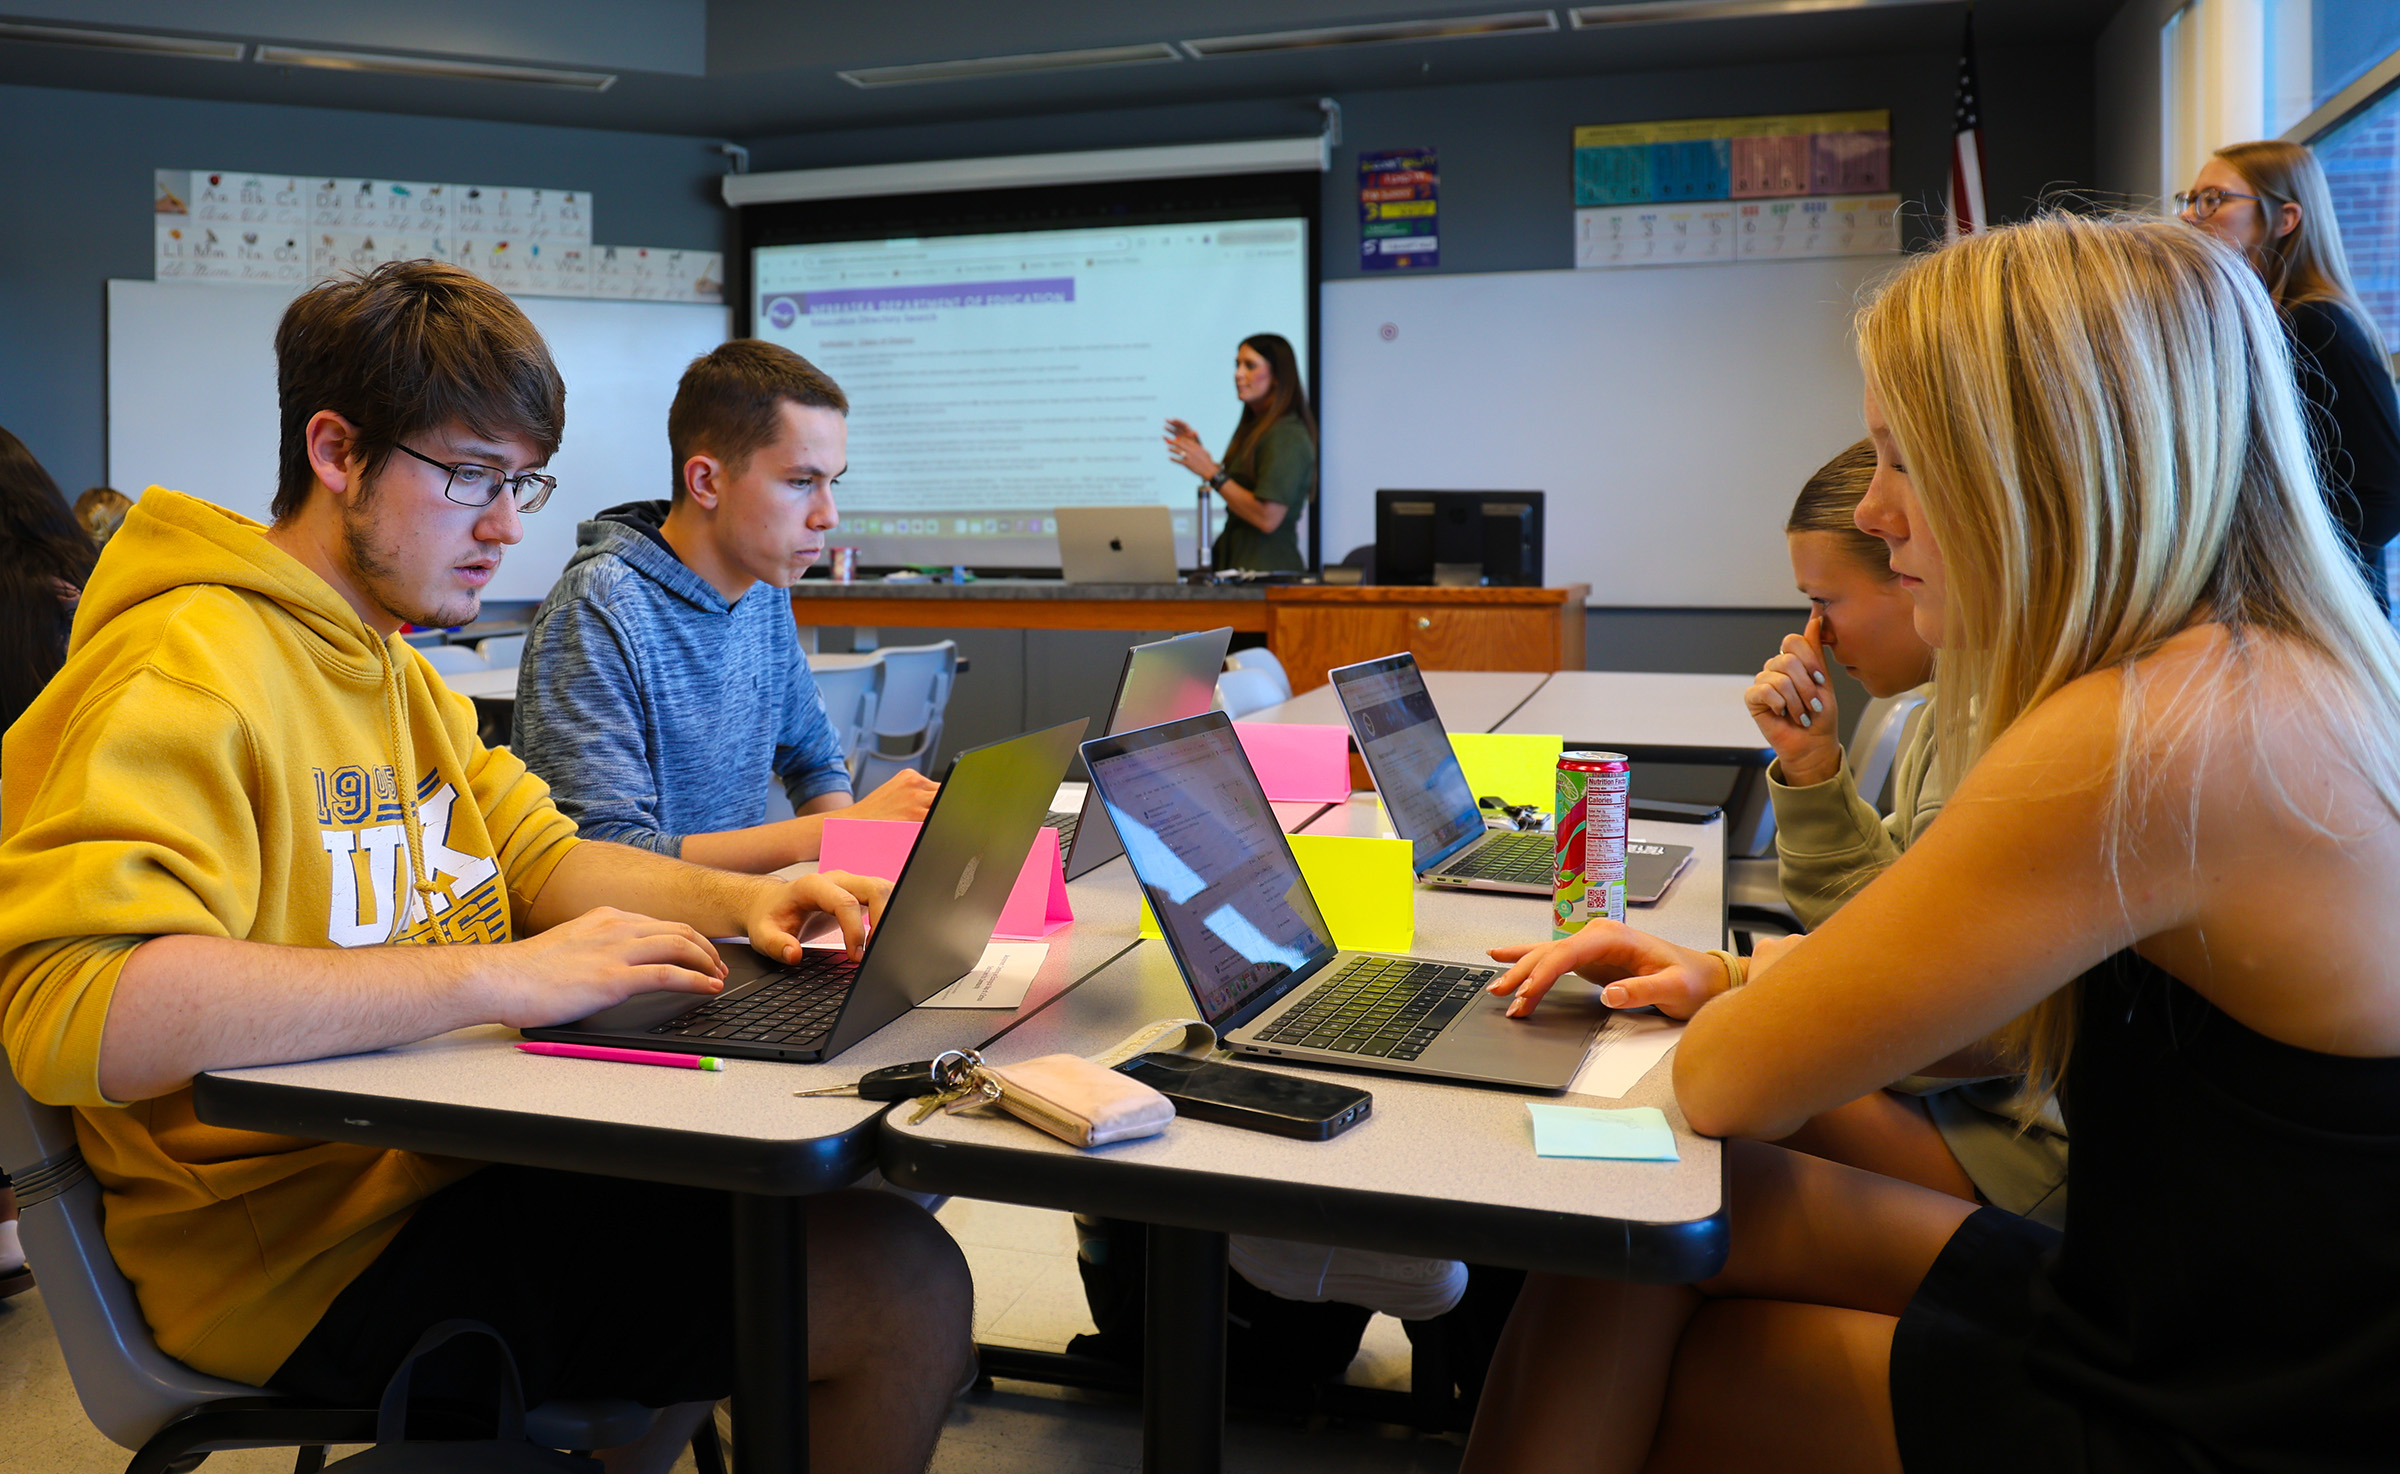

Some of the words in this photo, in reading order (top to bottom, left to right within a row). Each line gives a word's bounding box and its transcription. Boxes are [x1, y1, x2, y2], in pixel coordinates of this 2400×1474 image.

[809, 301, 877, 316] NEBRASKA
[879, 296, 962, 312] DEPARTMENT
[965, 294, 983, 307] OF
[986, 291, 1067, 307] EDUCATION
